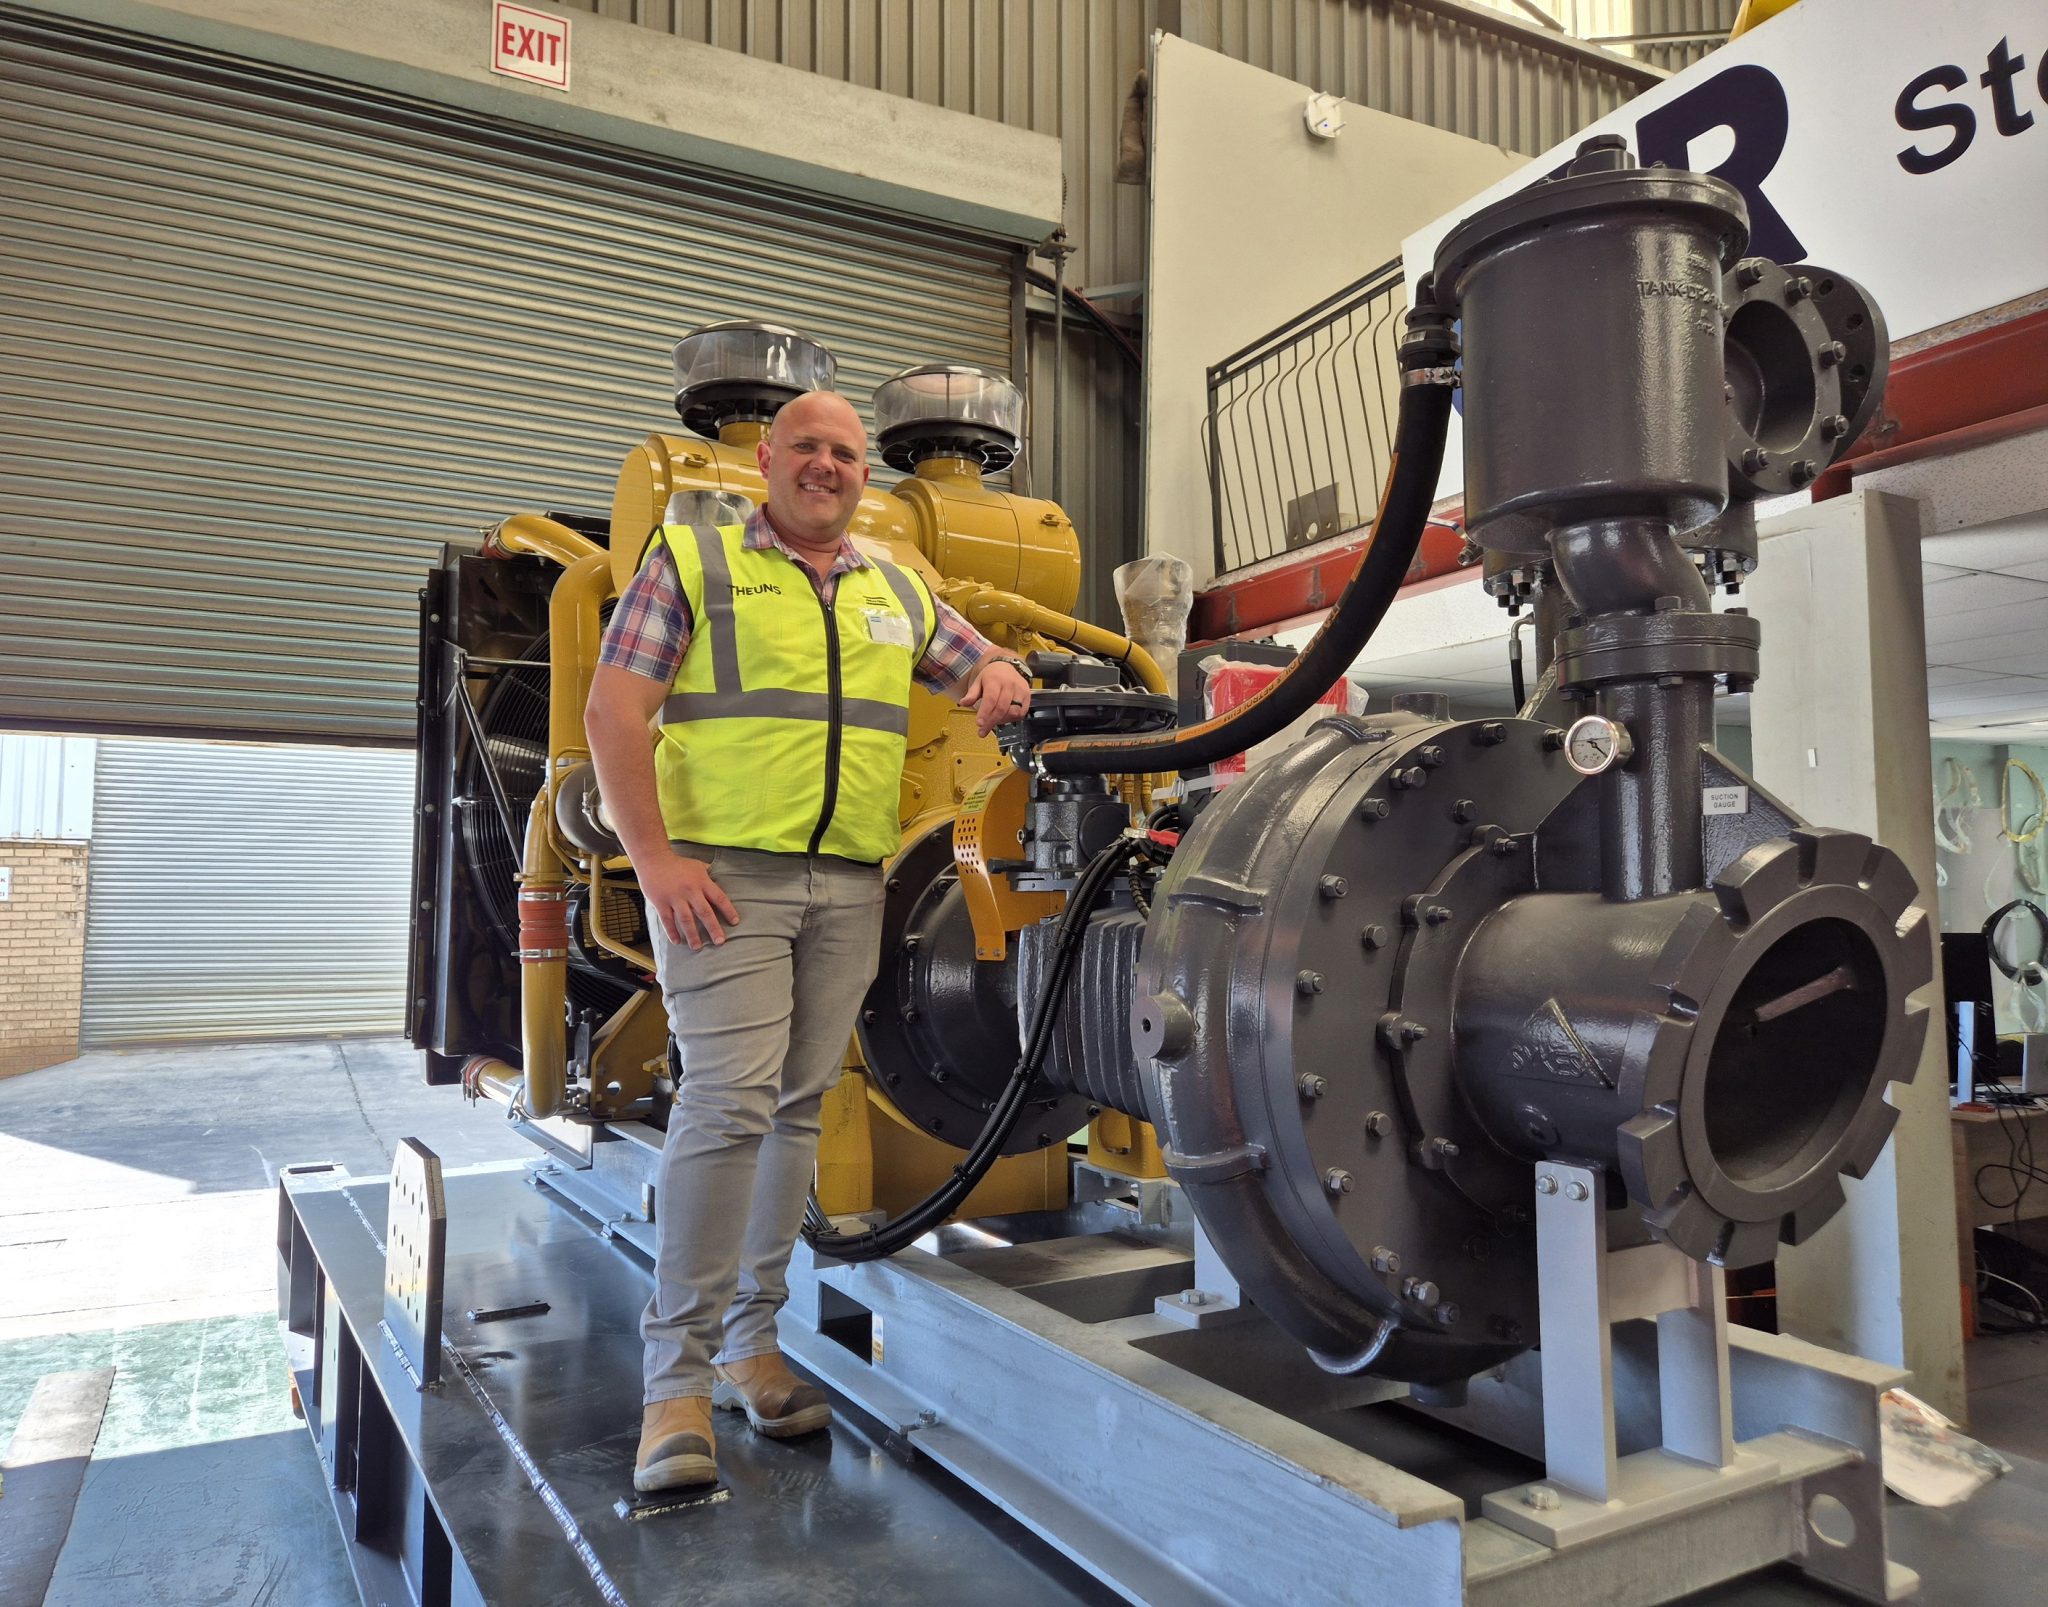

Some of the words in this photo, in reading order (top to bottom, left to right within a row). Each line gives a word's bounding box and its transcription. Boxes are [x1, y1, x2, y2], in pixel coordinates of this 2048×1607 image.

[502, 21, 561, 67] EXIT
[1894, 35, 2048, 175] St
[726, 583, 781, 596] THEUNS
